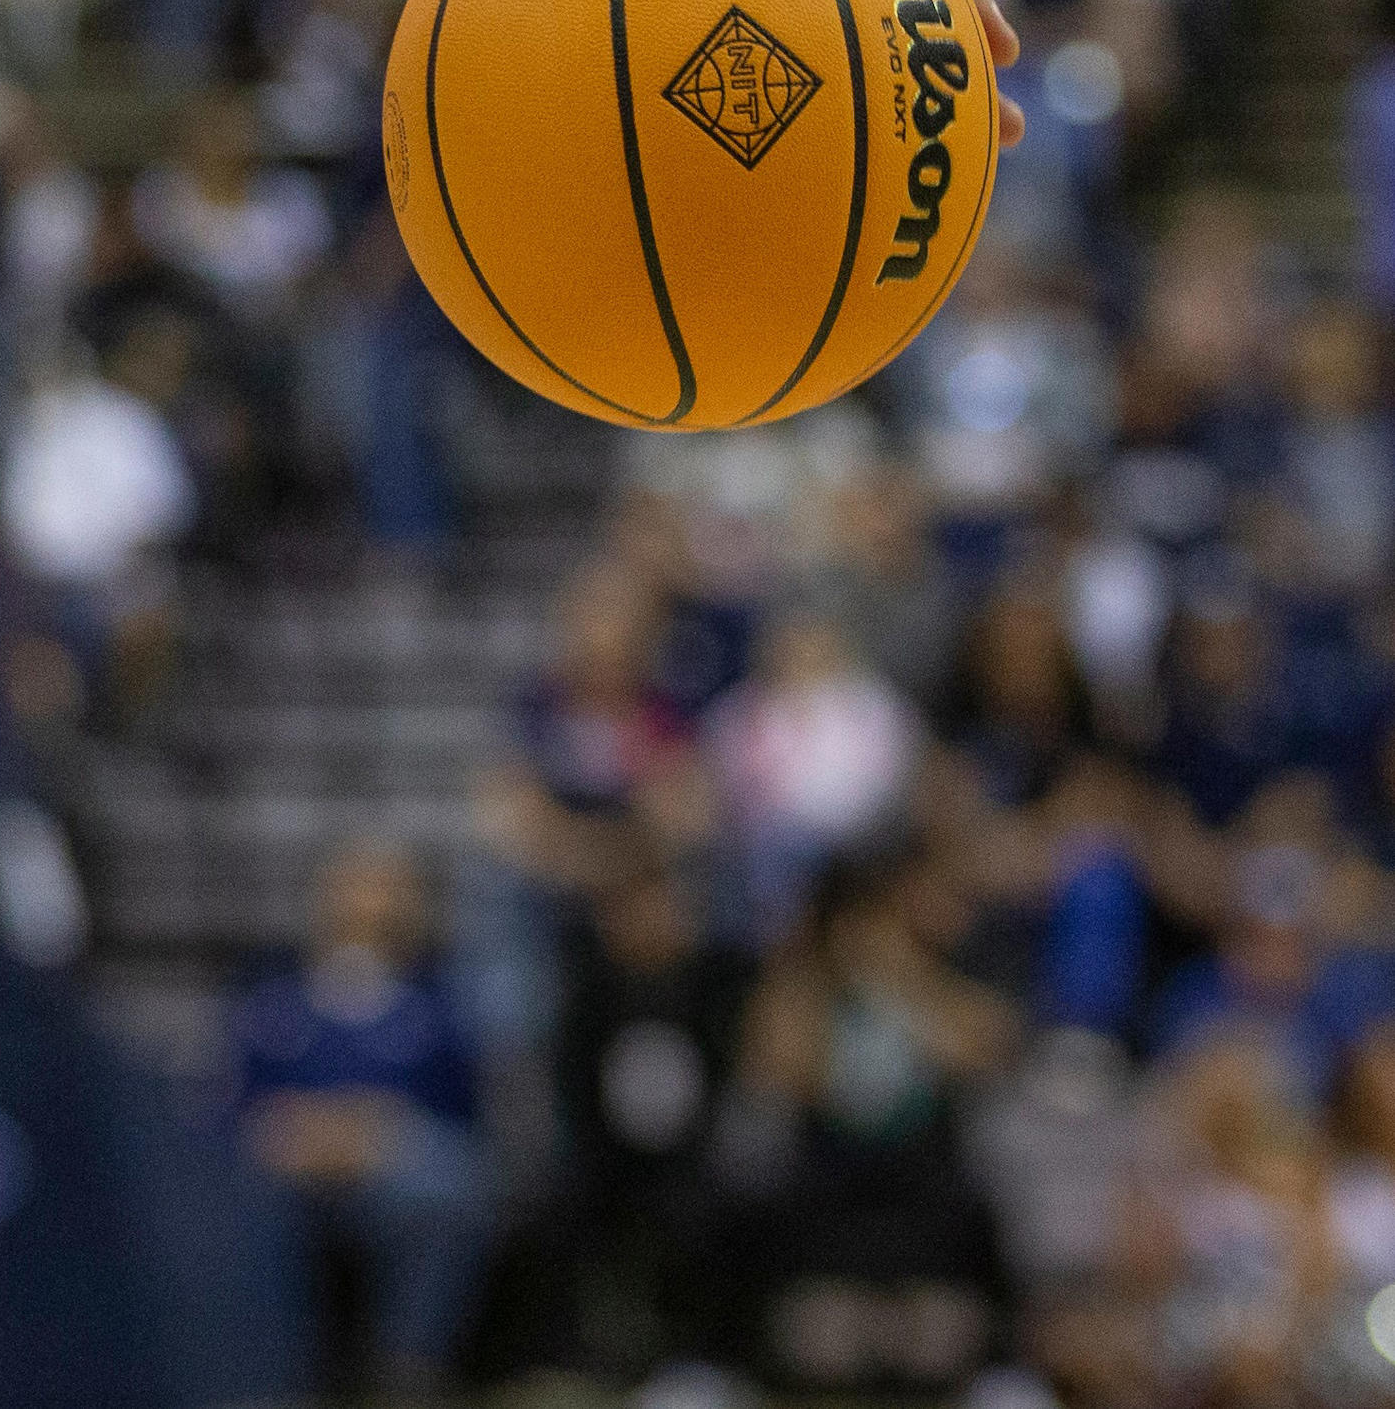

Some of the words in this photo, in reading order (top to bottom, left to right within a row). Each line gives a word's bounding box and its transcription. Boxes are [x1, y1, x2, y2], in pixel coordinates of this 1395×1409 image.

[727, 45, 759, 125] NIT
[881, 16, 902, 74] EVO
[893, 84, 907, 144] NXT
